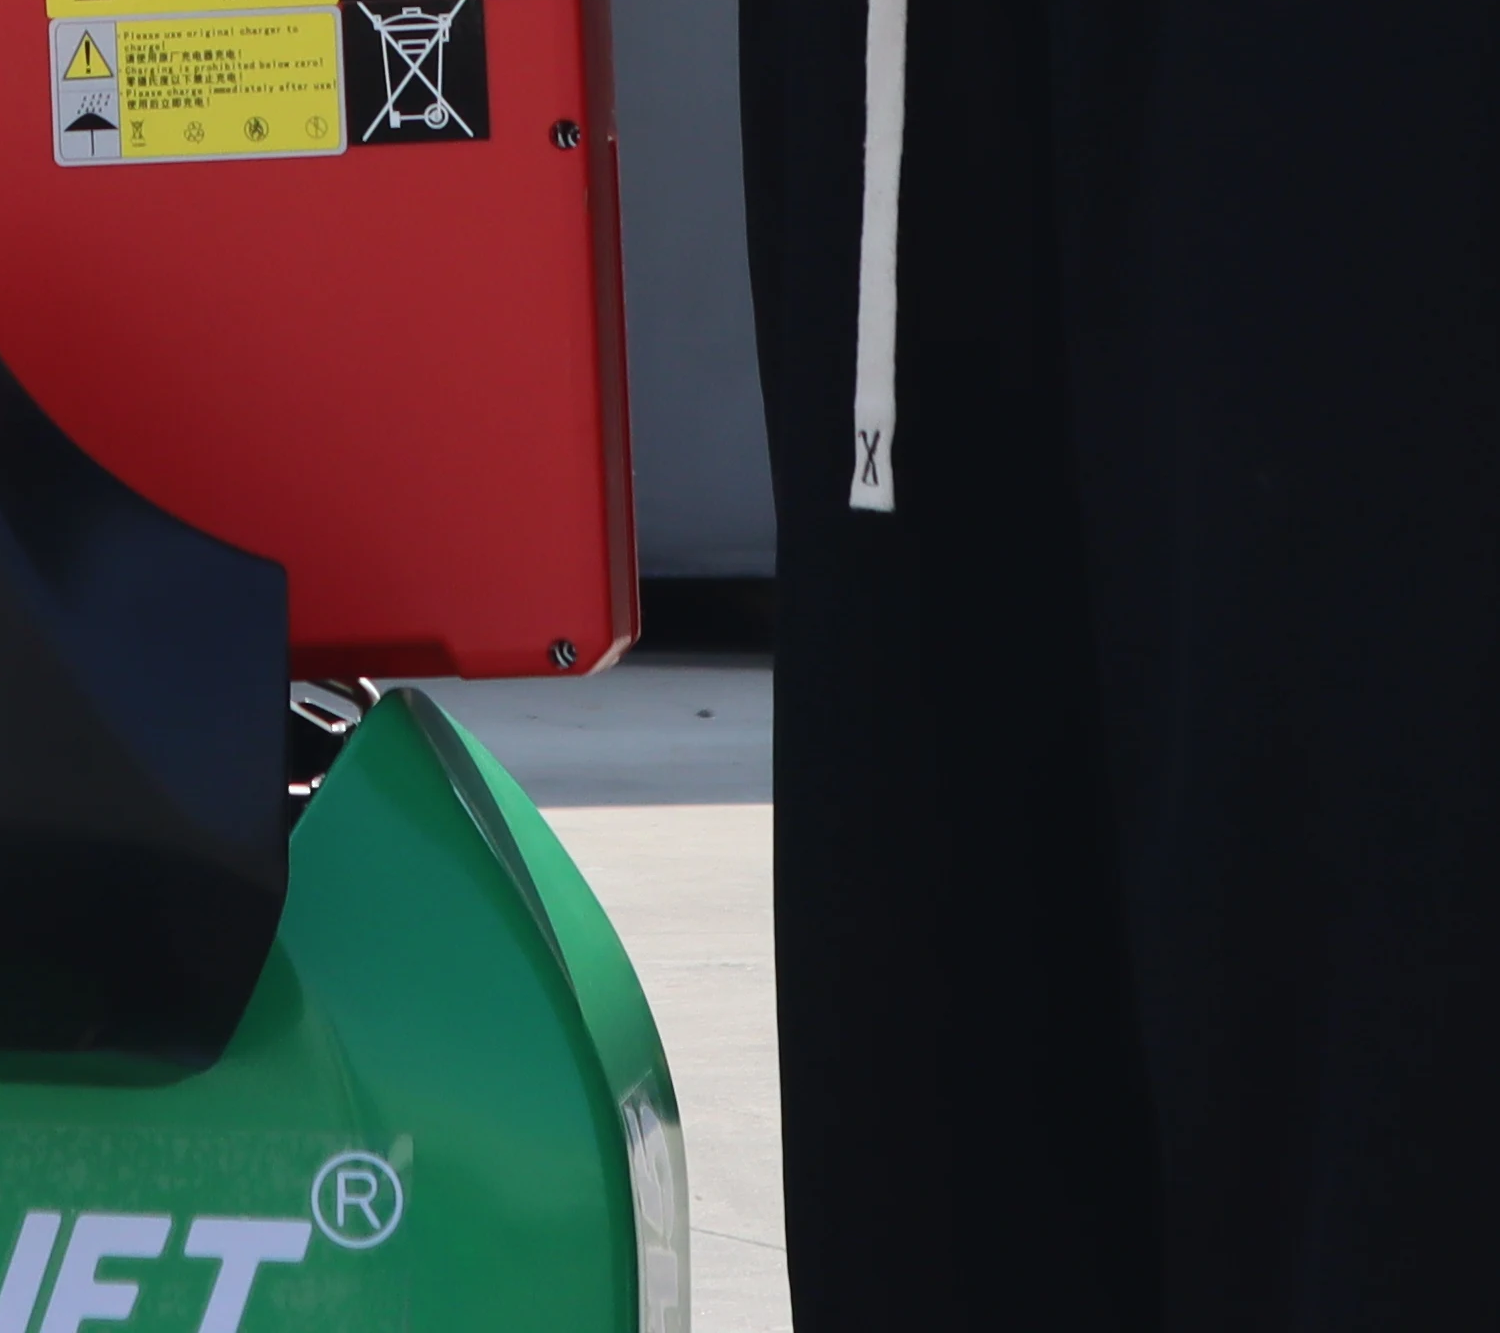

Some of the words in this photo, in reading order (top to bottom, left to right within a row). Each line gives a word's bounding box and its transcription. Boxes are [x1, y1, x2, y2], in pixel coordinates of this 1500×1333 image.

[123, 30, 160, 41] Please
[164, 30, 182, 39] use
[187, 27, 234, 40] original
[239, 25, 281, 36] charger
[126, 88, 163, 99] Please
